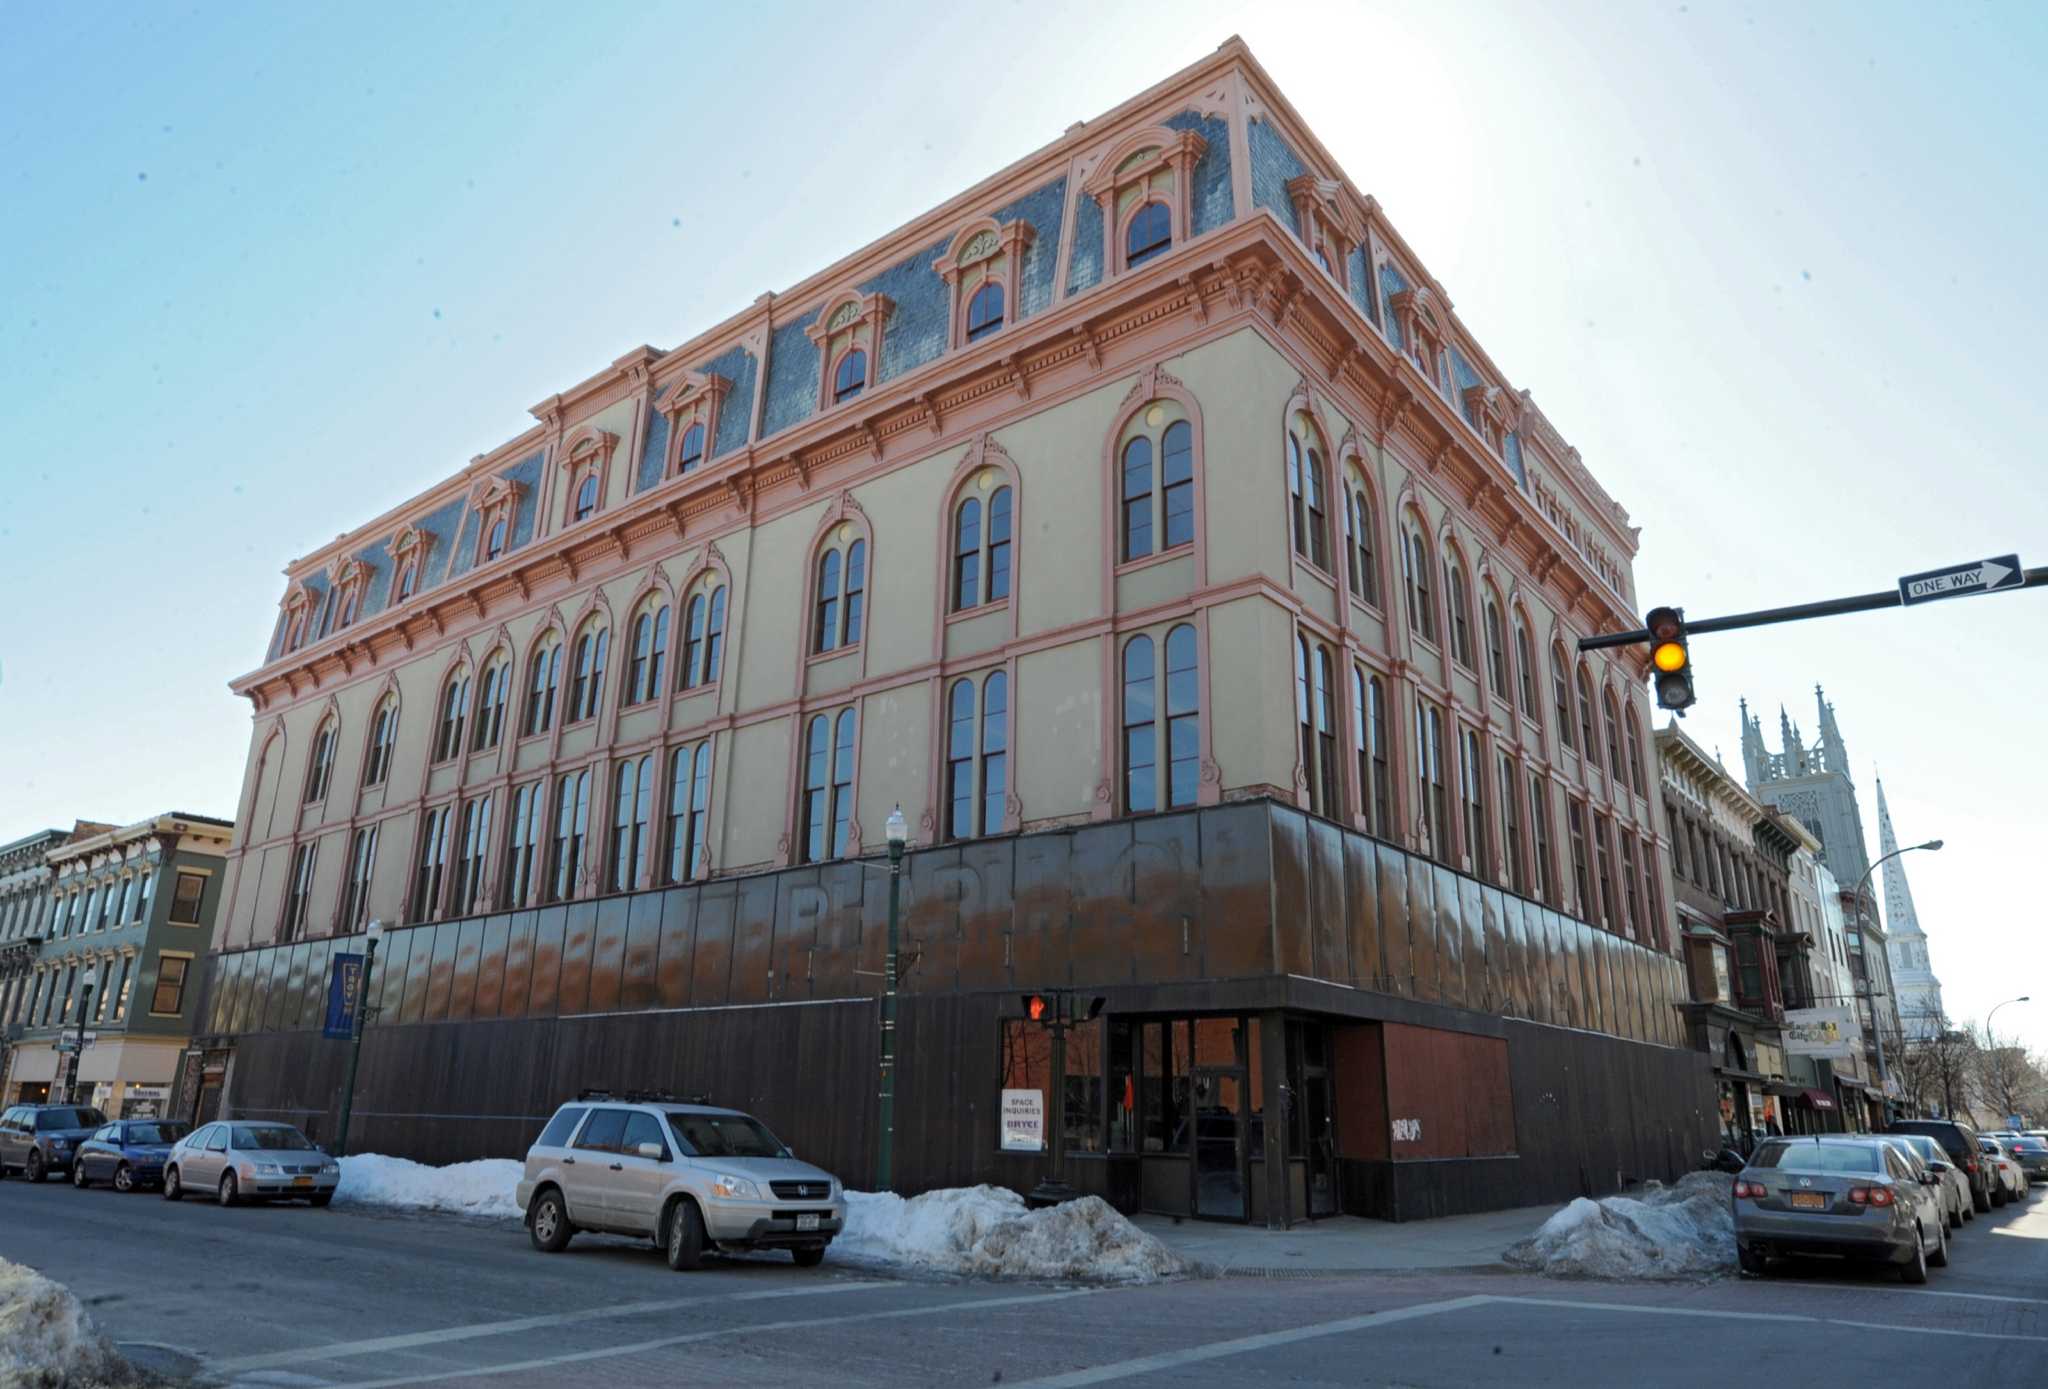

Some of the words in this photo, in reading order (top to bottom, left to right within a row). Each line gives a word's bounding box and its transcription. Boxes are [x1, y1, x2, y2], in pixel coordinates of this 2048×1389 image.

[1913, 579, 1944, 595] ONE
[1950, 570, 1982, 587] WAY
[1011, 1098, 1033, 1106] SPACE
[1003, 1106, 1041, 1116] INQUIRIES
